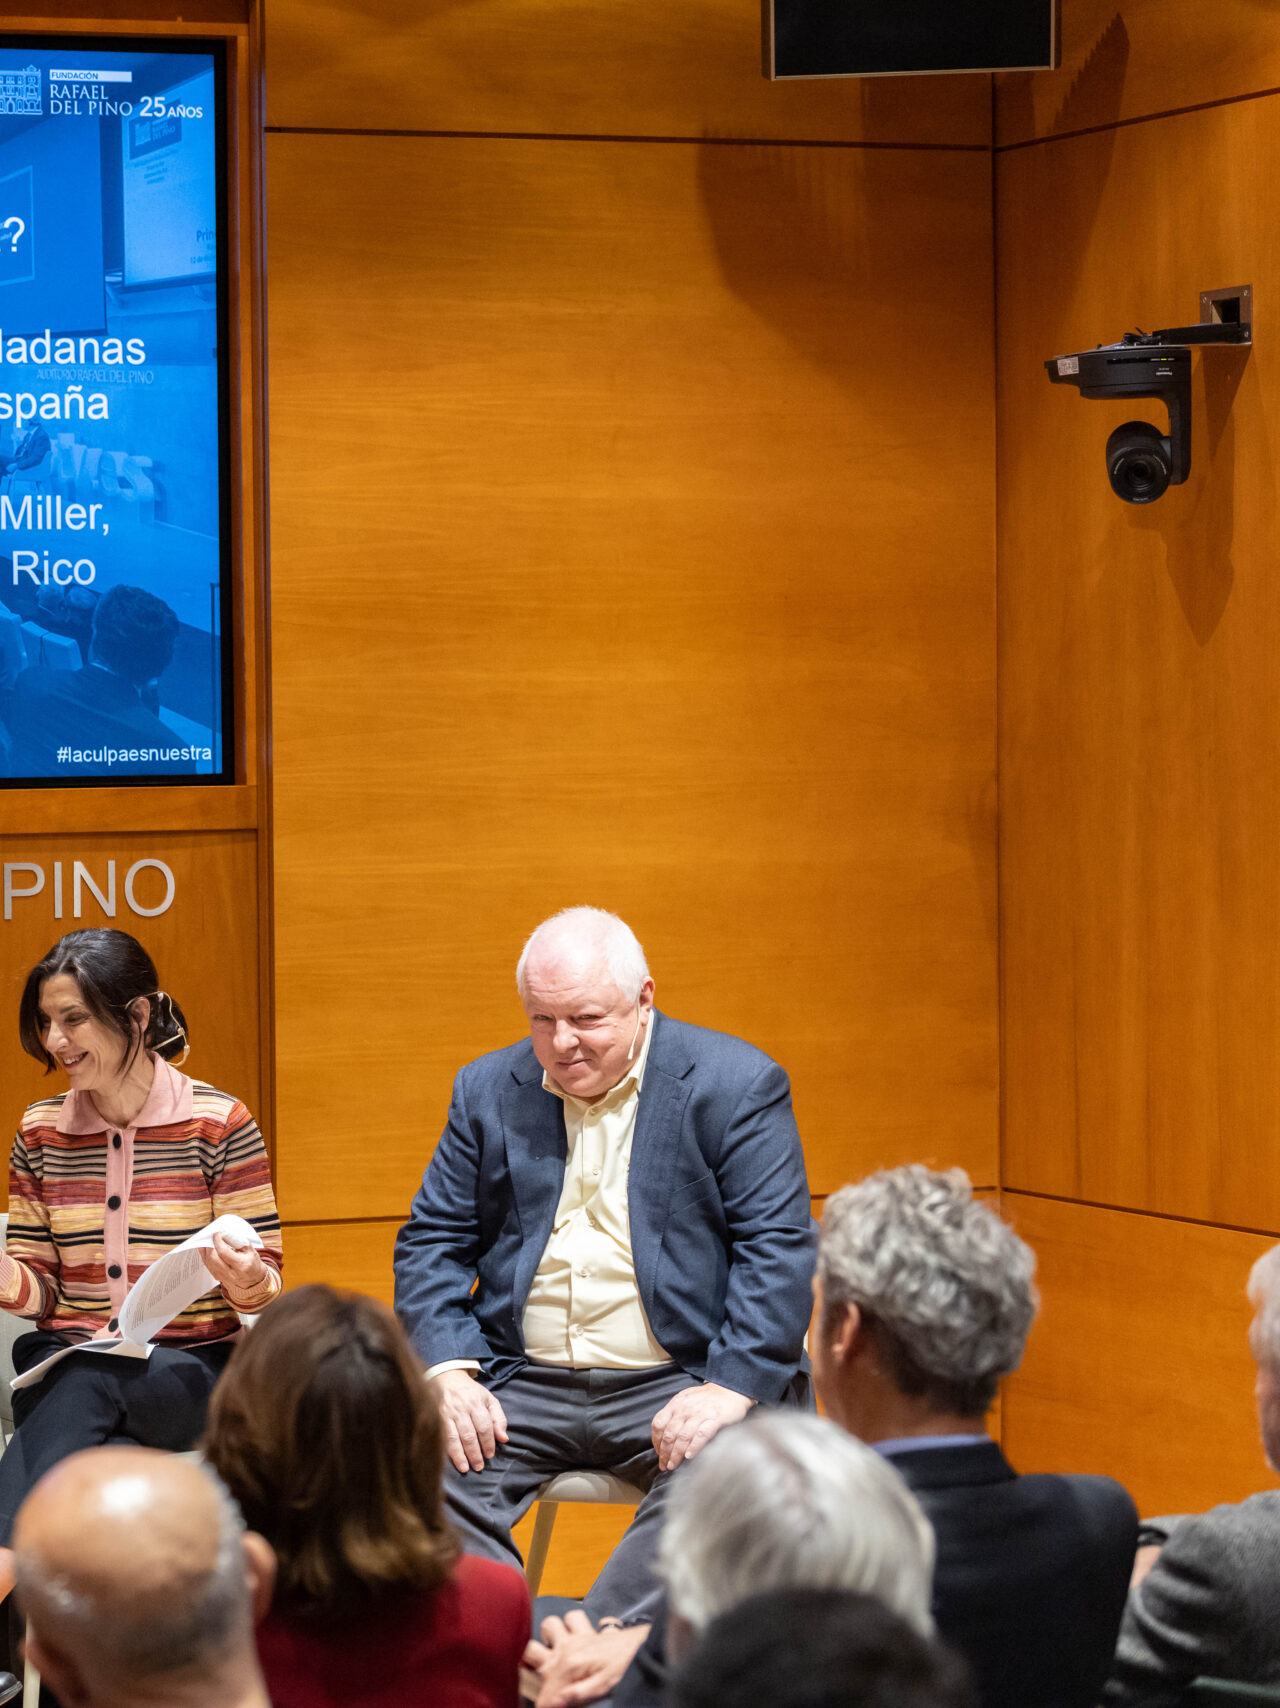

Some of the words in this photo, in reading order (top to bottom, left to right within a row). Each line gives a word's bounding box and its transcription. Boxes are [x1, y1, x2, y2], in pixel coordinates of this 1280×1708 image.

[51, 72, 99, 80] FUNDACIÓN
[50, 85, 108, 99] RAFAEL
[50, 100, 82, 115] DEL
[88, 101, 133, 116] PINO
[140, 97, 165, 117] 25
[168, 105, 202, 118] AÑOS
[109, 370, 127, 383] DEL
[128, 370, 154, 384] PINO
[1, 496, 108, 535] Miller,
[13, 551, 95, 584] Rico
[58, 746, 211, 765] #laculpaesnuestra
[4, 859, 175, 919] PINO
